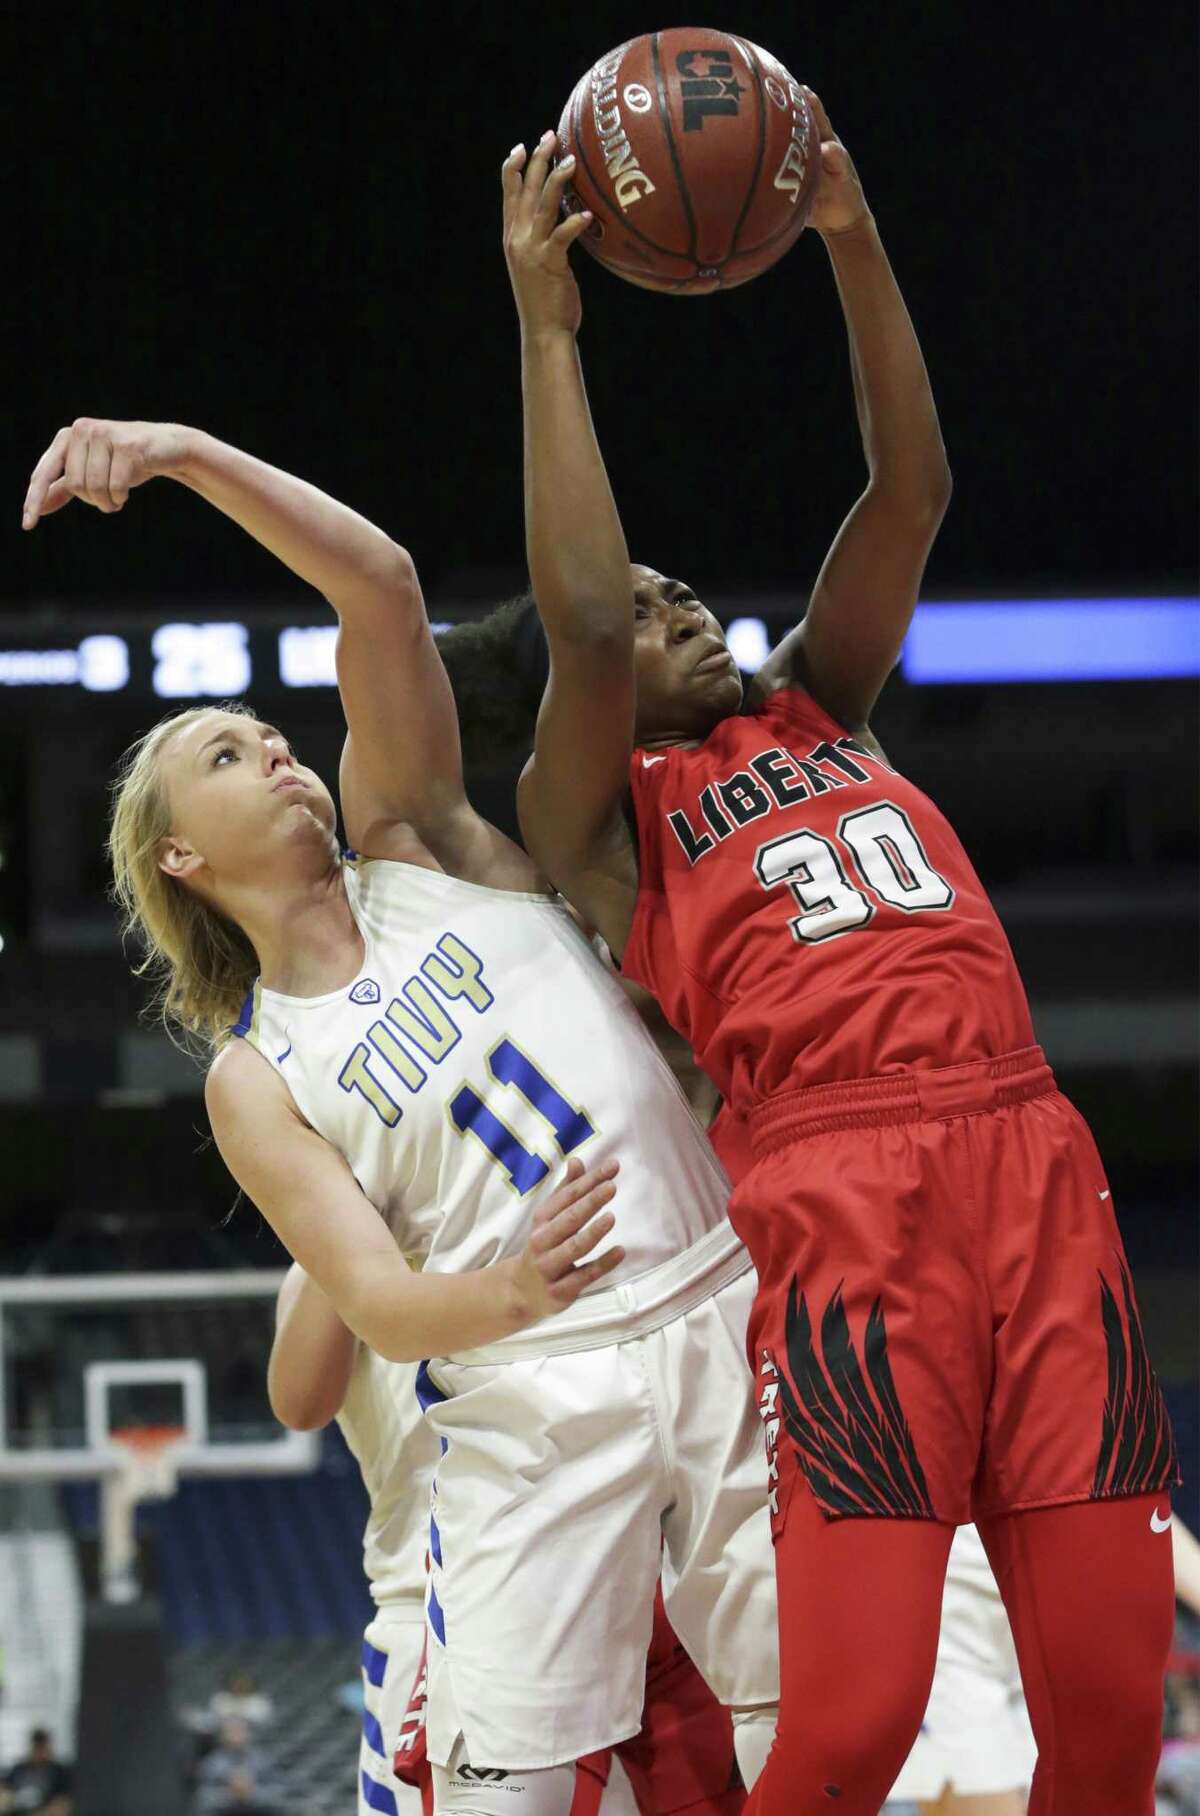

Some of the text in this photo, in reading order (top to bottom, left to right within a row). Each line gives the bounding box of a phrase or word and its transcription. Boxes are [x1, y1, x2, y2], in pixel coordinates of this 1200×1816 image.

[753, 800, 955, 945] 30
[338, 932, 495, 1128] TIVY
[446, 1033, 602, 1199] 11
